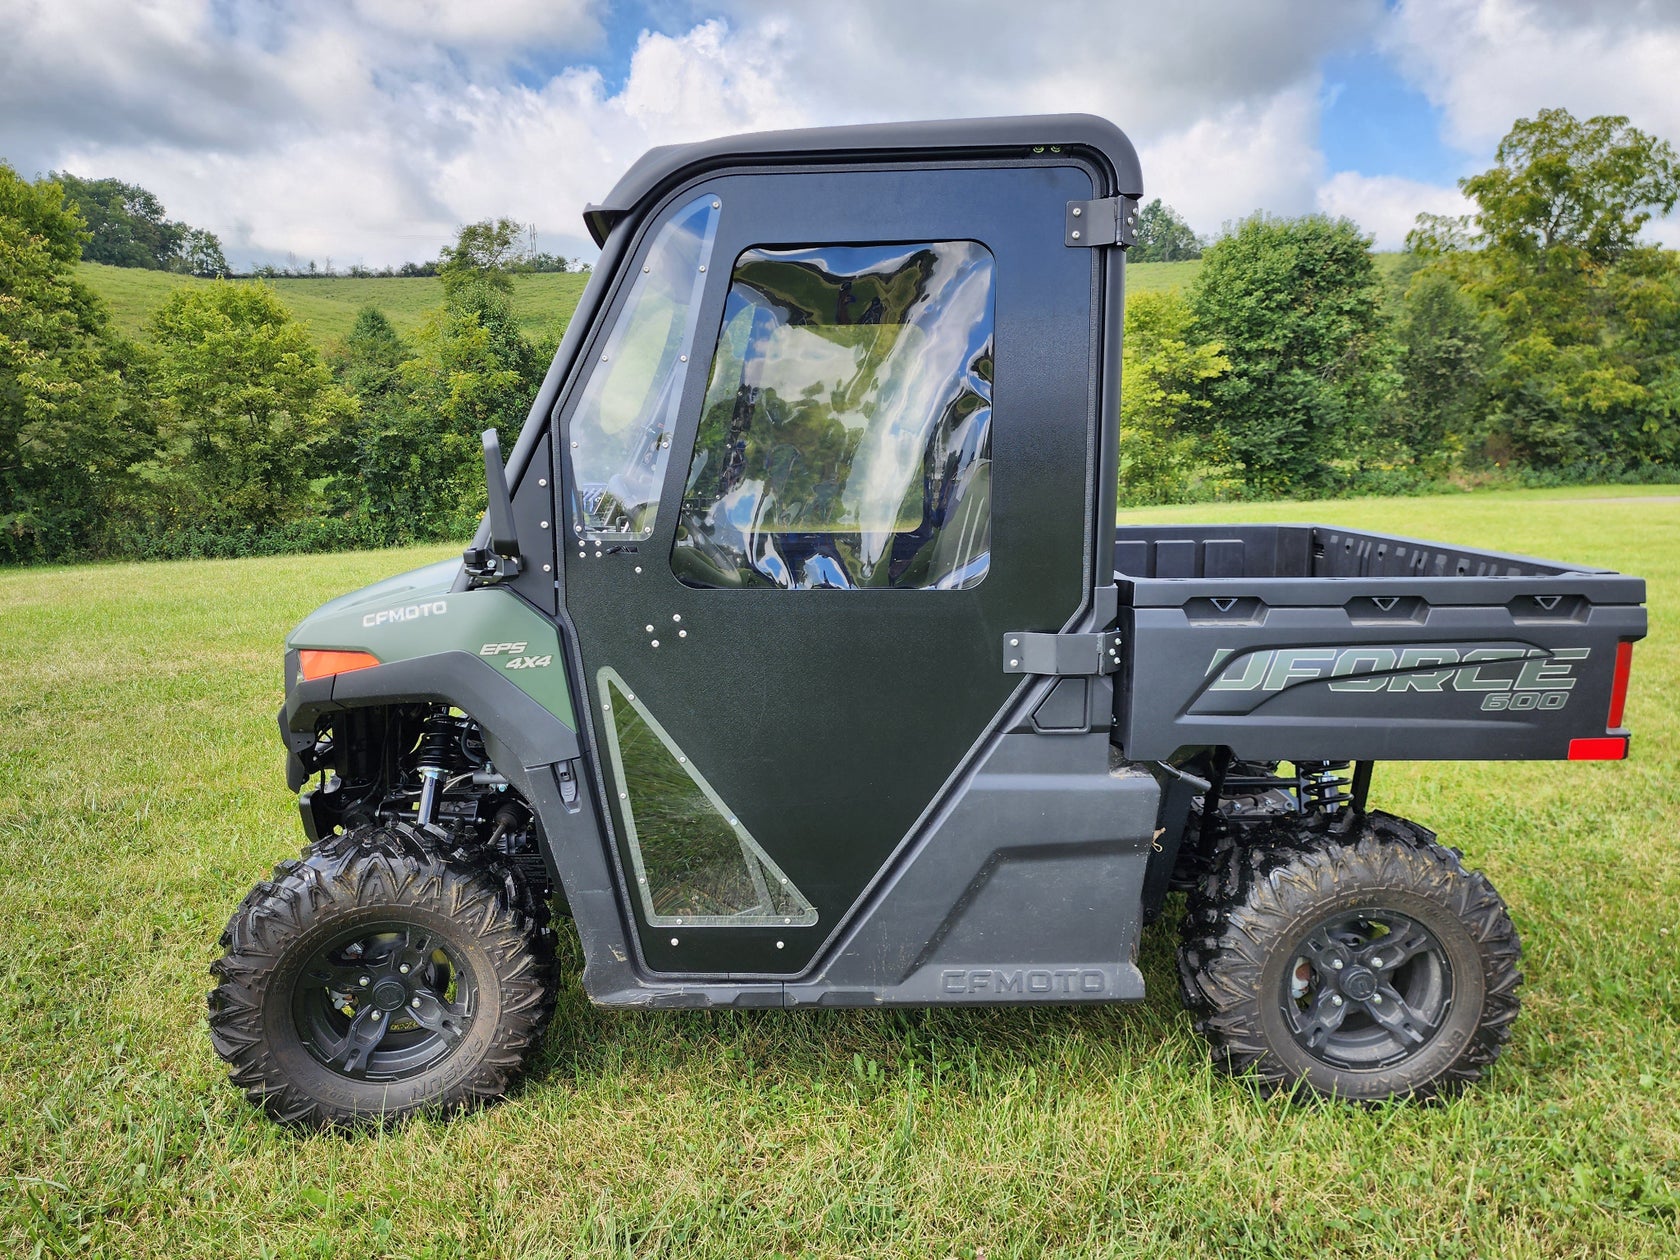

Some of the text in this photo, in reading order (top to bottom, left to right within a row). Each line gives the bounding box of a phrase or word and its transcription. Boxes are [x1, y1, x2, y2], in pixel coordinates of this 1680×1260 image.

[362, 600, 448, 628] CFMOTO
[479, 641, 528, 656] EPS
[1480, 691, 1570, 711] 600
[941, 968, 1105, 994] CFMOTO
